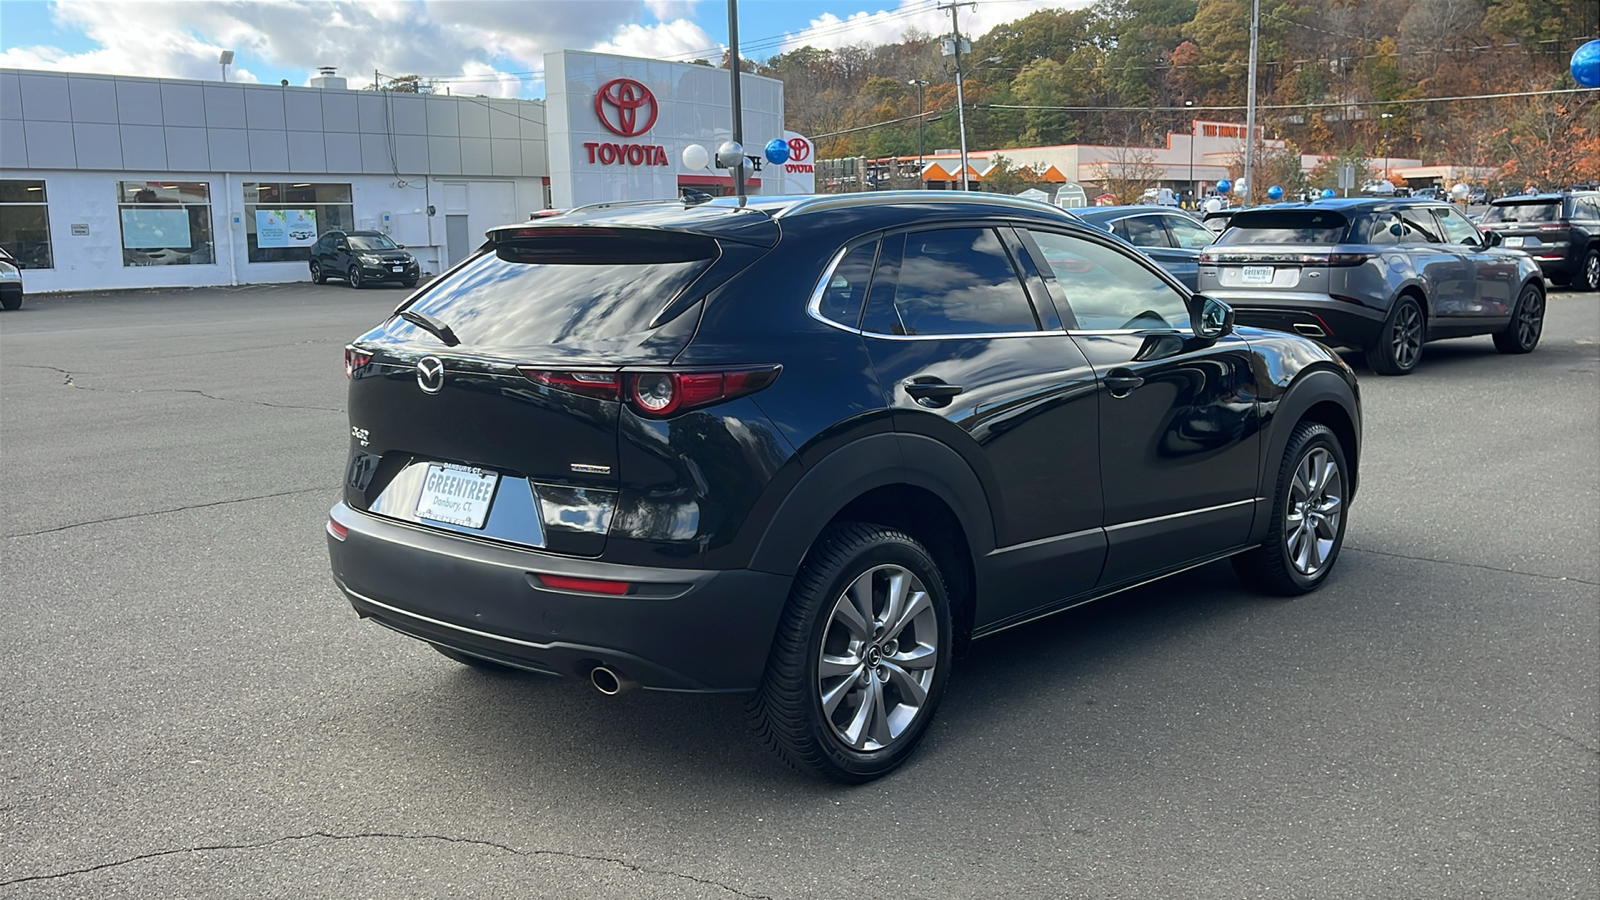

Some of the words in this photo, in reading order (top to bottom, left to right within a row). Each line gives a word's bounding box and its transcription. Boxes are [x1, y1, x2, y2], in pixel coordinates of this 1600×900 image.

[583, 142, 669, 166] TOYOTA
[785, 164, 813, 173] OYOTA
[427, 473, 491, 502] GREENTREE
[433, 495, 461, 512] Danbury,
